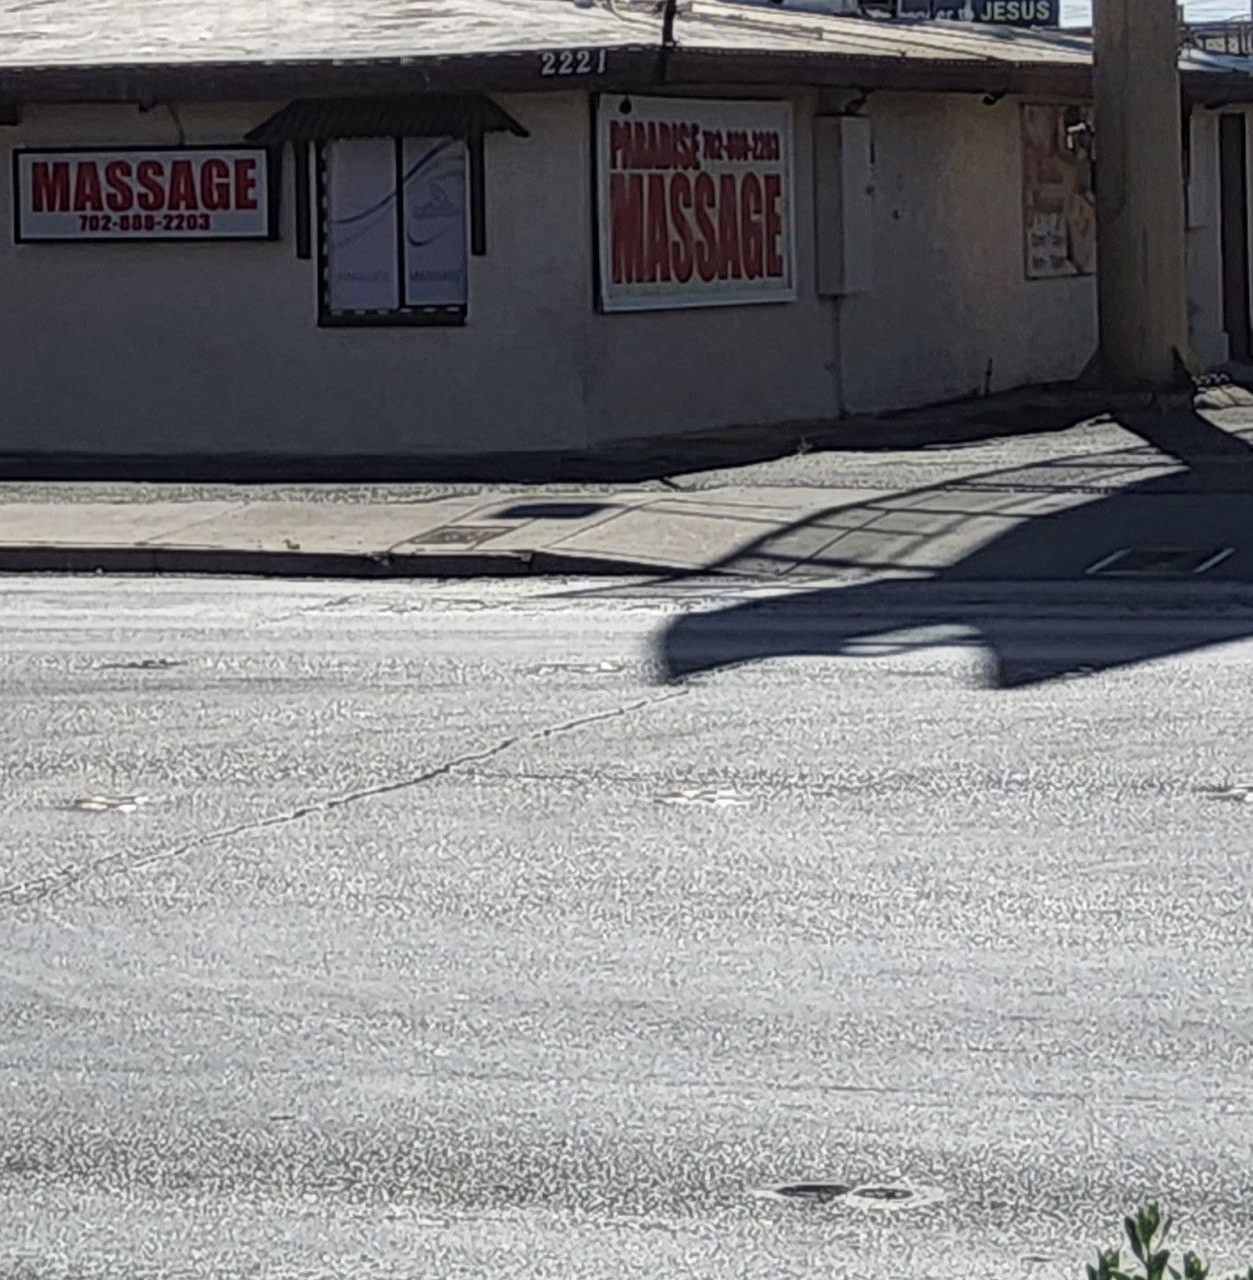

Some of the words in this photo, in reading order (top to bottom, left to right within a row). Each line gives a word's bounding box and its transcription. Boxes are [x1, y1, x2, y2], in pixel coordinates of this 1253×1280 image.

[980, 0, 1051, 22] JESUS
[541, 49, 606, 76] 2221
[610, 119, 701, 170] PARADISE
[31, 158, 258, 213] MASSAGE
[610, 172, 783, 284] MASSAGE
